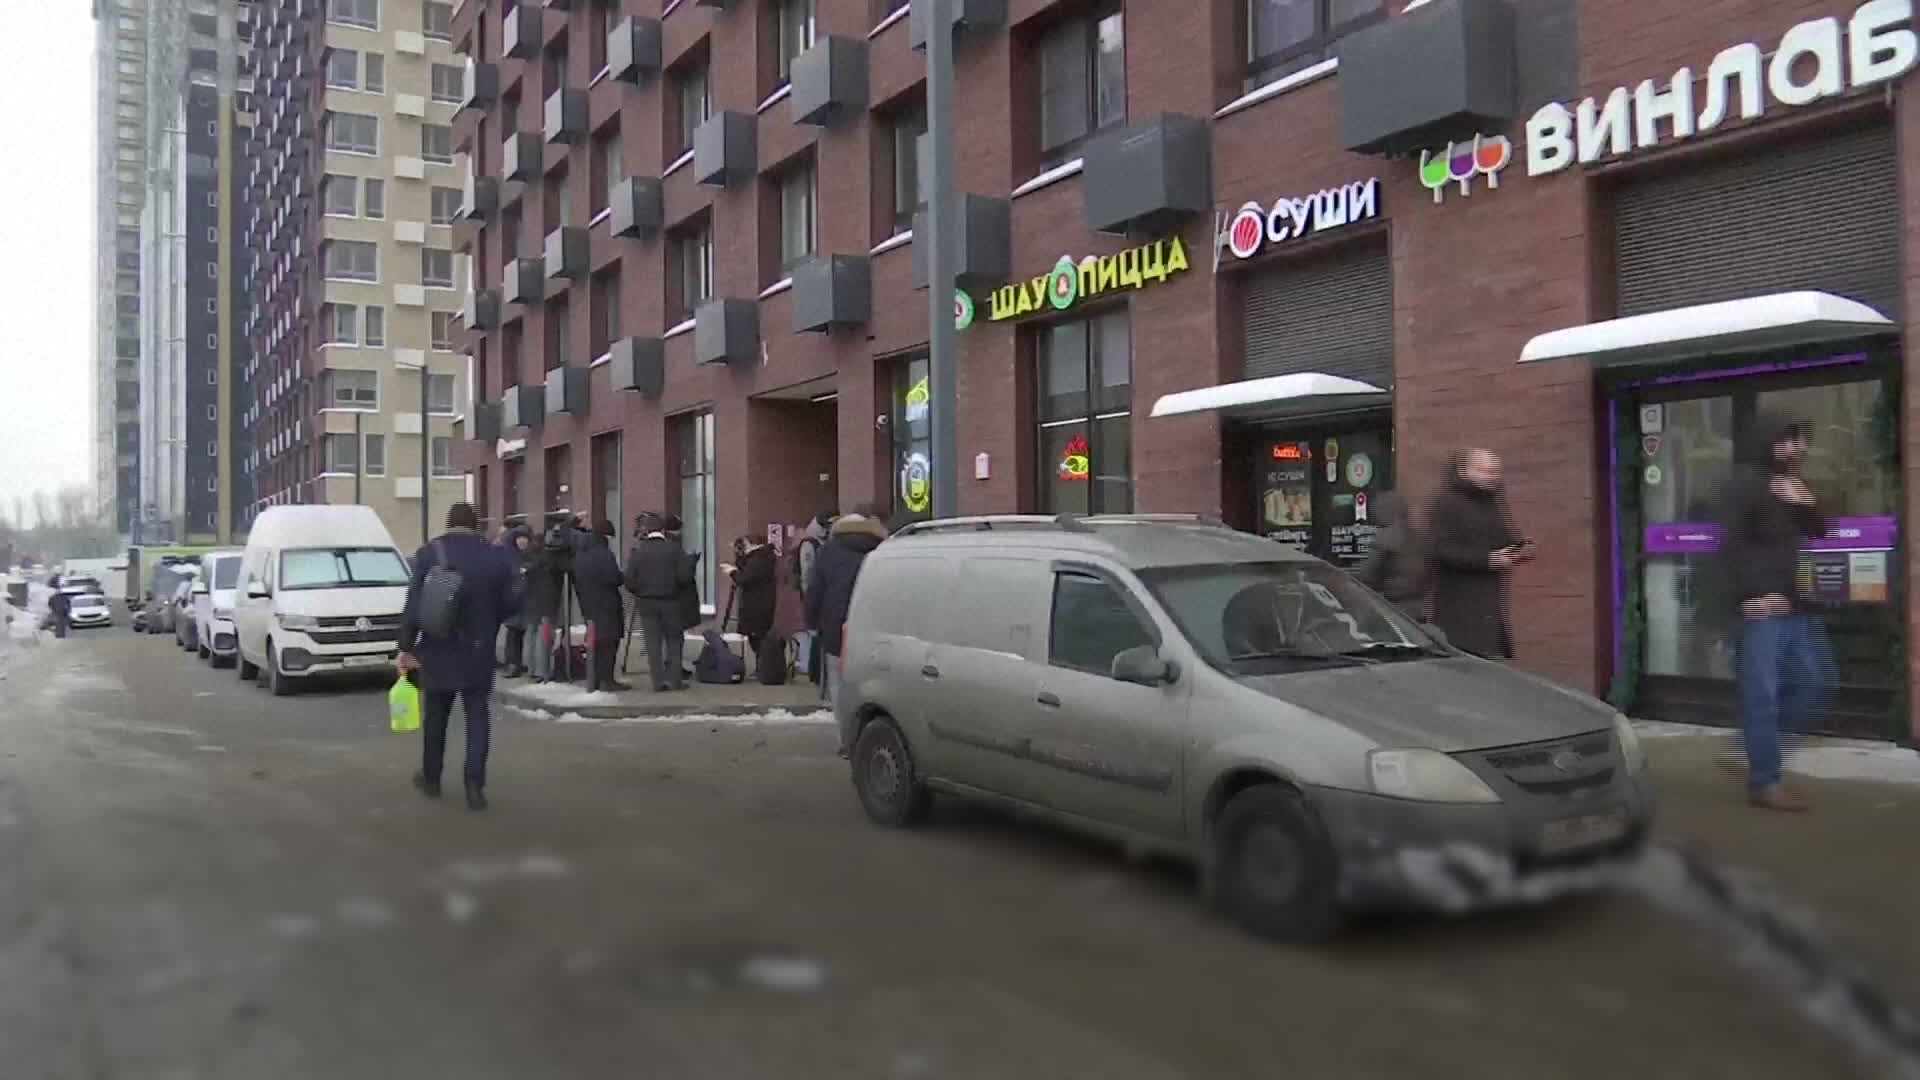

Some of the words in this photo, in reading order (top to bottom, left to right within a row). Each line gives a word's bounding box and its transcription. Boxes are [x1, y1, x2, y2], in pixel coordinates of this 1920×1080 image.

[1267, 178, 1377, 243] СУШИ
[991, 273, 1051, 320] ШАУ
[1078, 236, 1188, 297] ПИЦЦА
